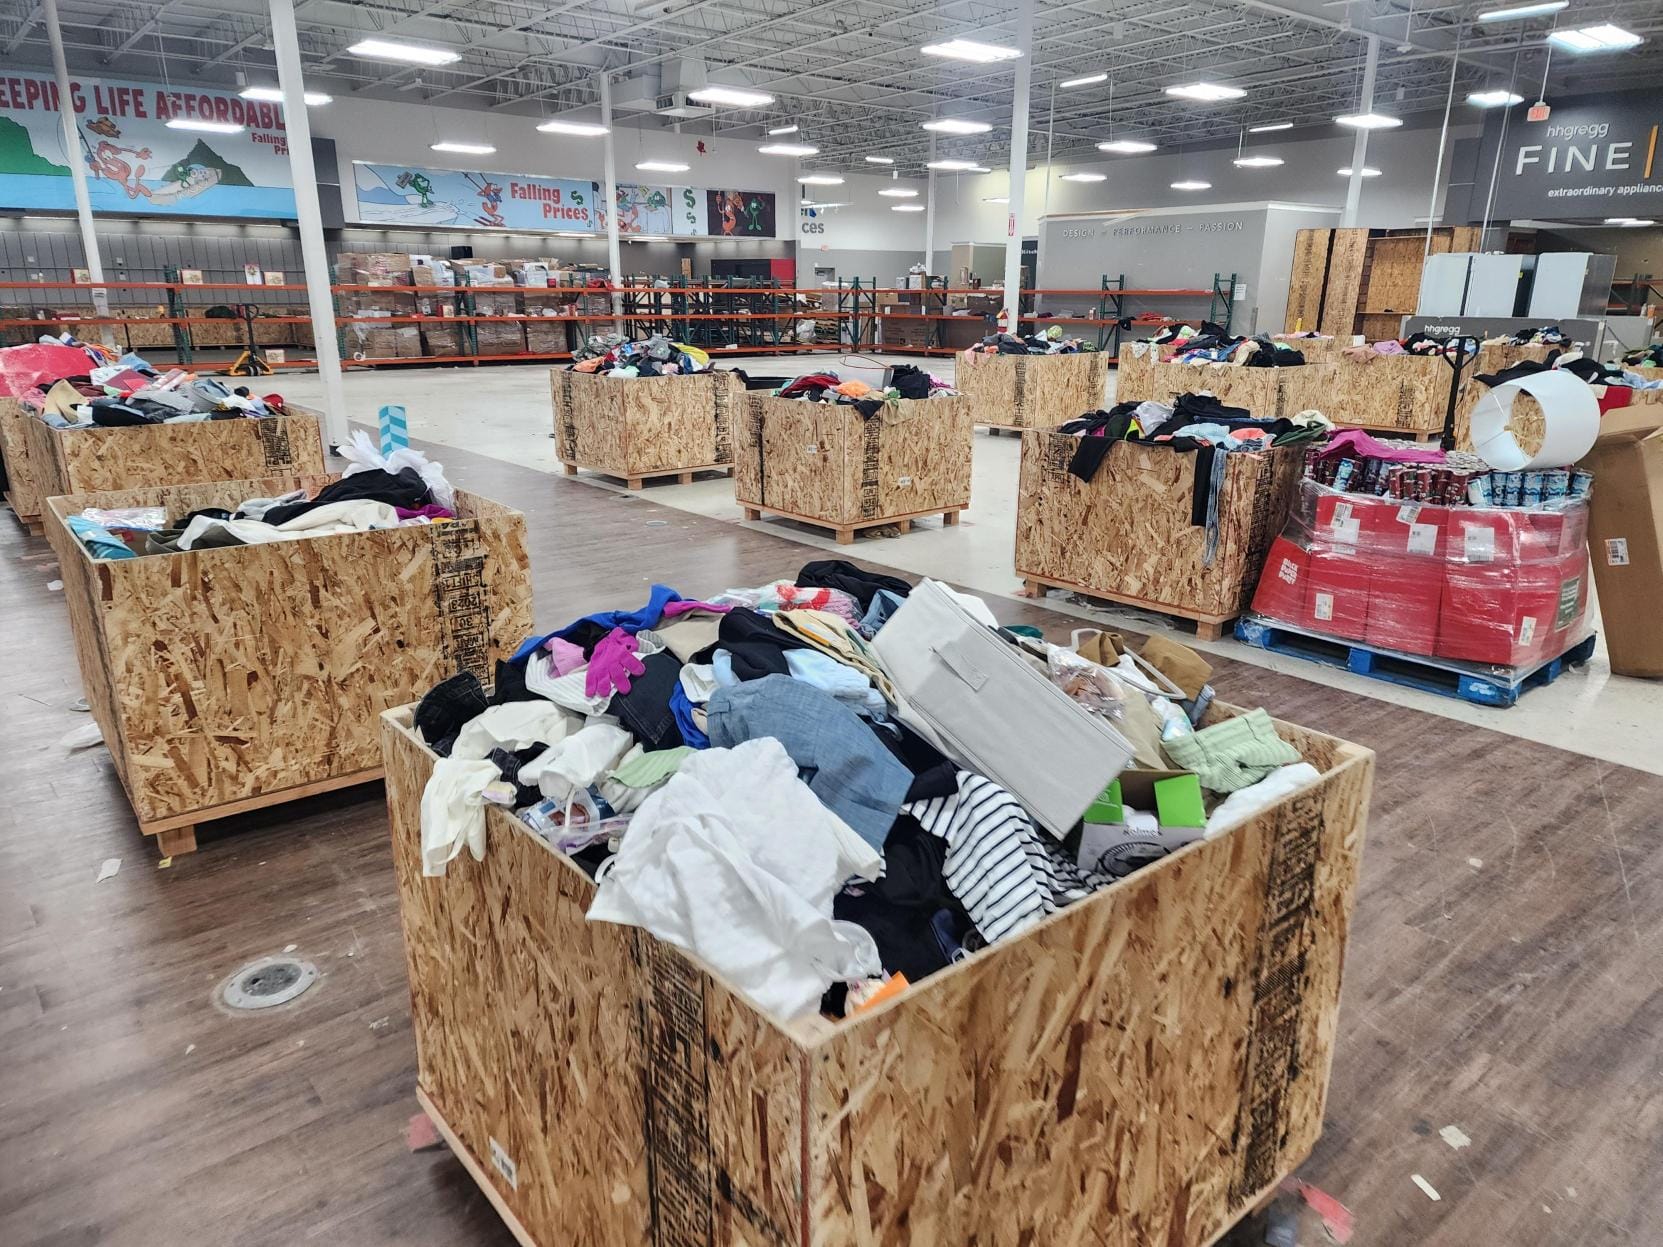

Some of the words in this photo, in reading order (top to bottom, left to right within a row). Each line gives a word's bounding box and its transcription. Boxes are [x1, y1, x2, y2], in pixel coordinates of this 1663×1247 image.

[0, 77, 86, 113] EEPING
[94, 85, 147, 118] LIFE
[156, 91, 287, 130] AFFORDABL
[252, 132, 288, 146] Falling
[1547, 123, 1609, 140] hhgregg
[274, 145, 289, 155] Pri
[1515, 142, 1633, 175] FINE
[510, 182, 560, 204] Falling
[1548, 186, 1615, 198] extraordinary
[543, 203, 589, 220] Prices
[1063, 229, 1095, 238] DESIGN
[1113, 224, 1182, 237] PERFORMANCE
[1199, 221, 1244, 233] PASSION
[1424, 325, 1460, 336] hhgregg
